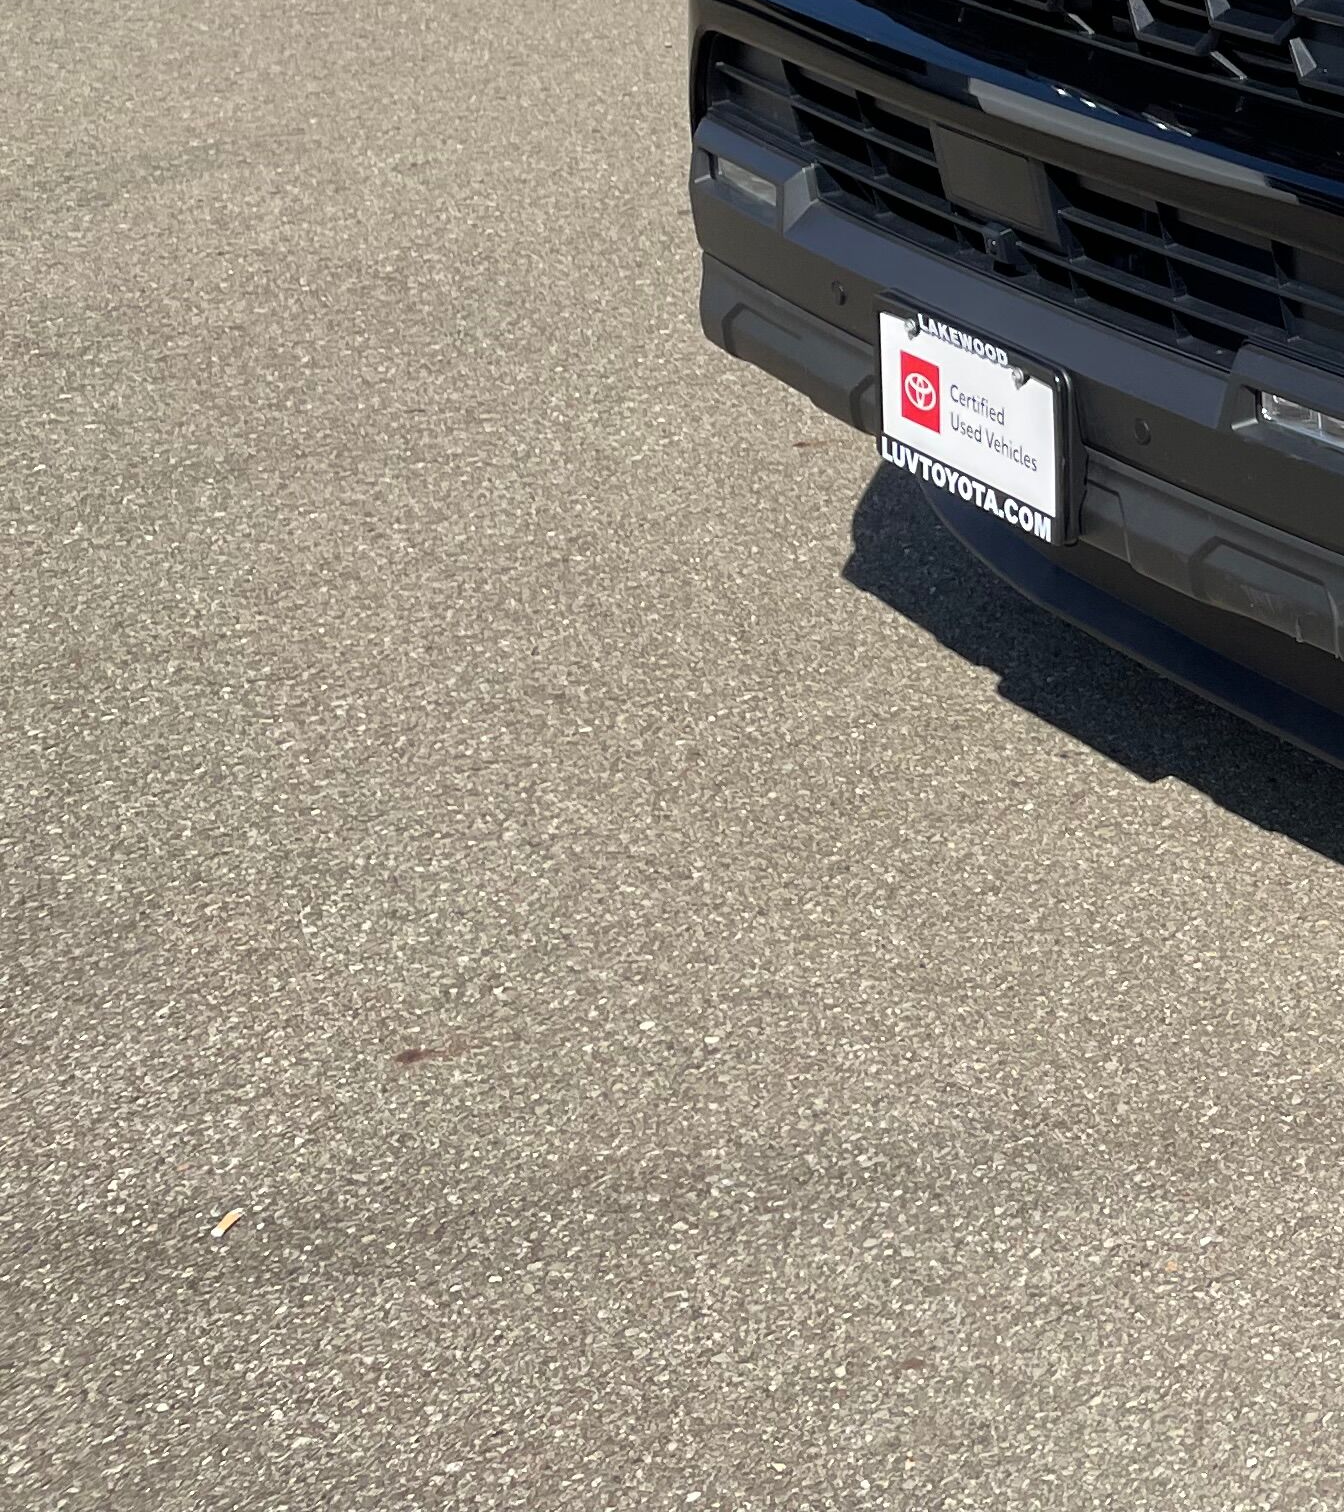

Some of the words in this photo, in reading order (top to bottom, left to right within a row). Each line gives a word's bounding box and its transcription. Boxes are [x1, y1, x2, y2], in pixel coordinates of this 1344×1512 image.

[917, 313, 1009, 366] LAKEWOOD
[950, 384, 1005, 426] Certified
[950, 411, 982, 443] Used
[986, 424, 1038, 472] Vehicles
[881, 435, 1052, 542] LUVTOYOTA.COM
